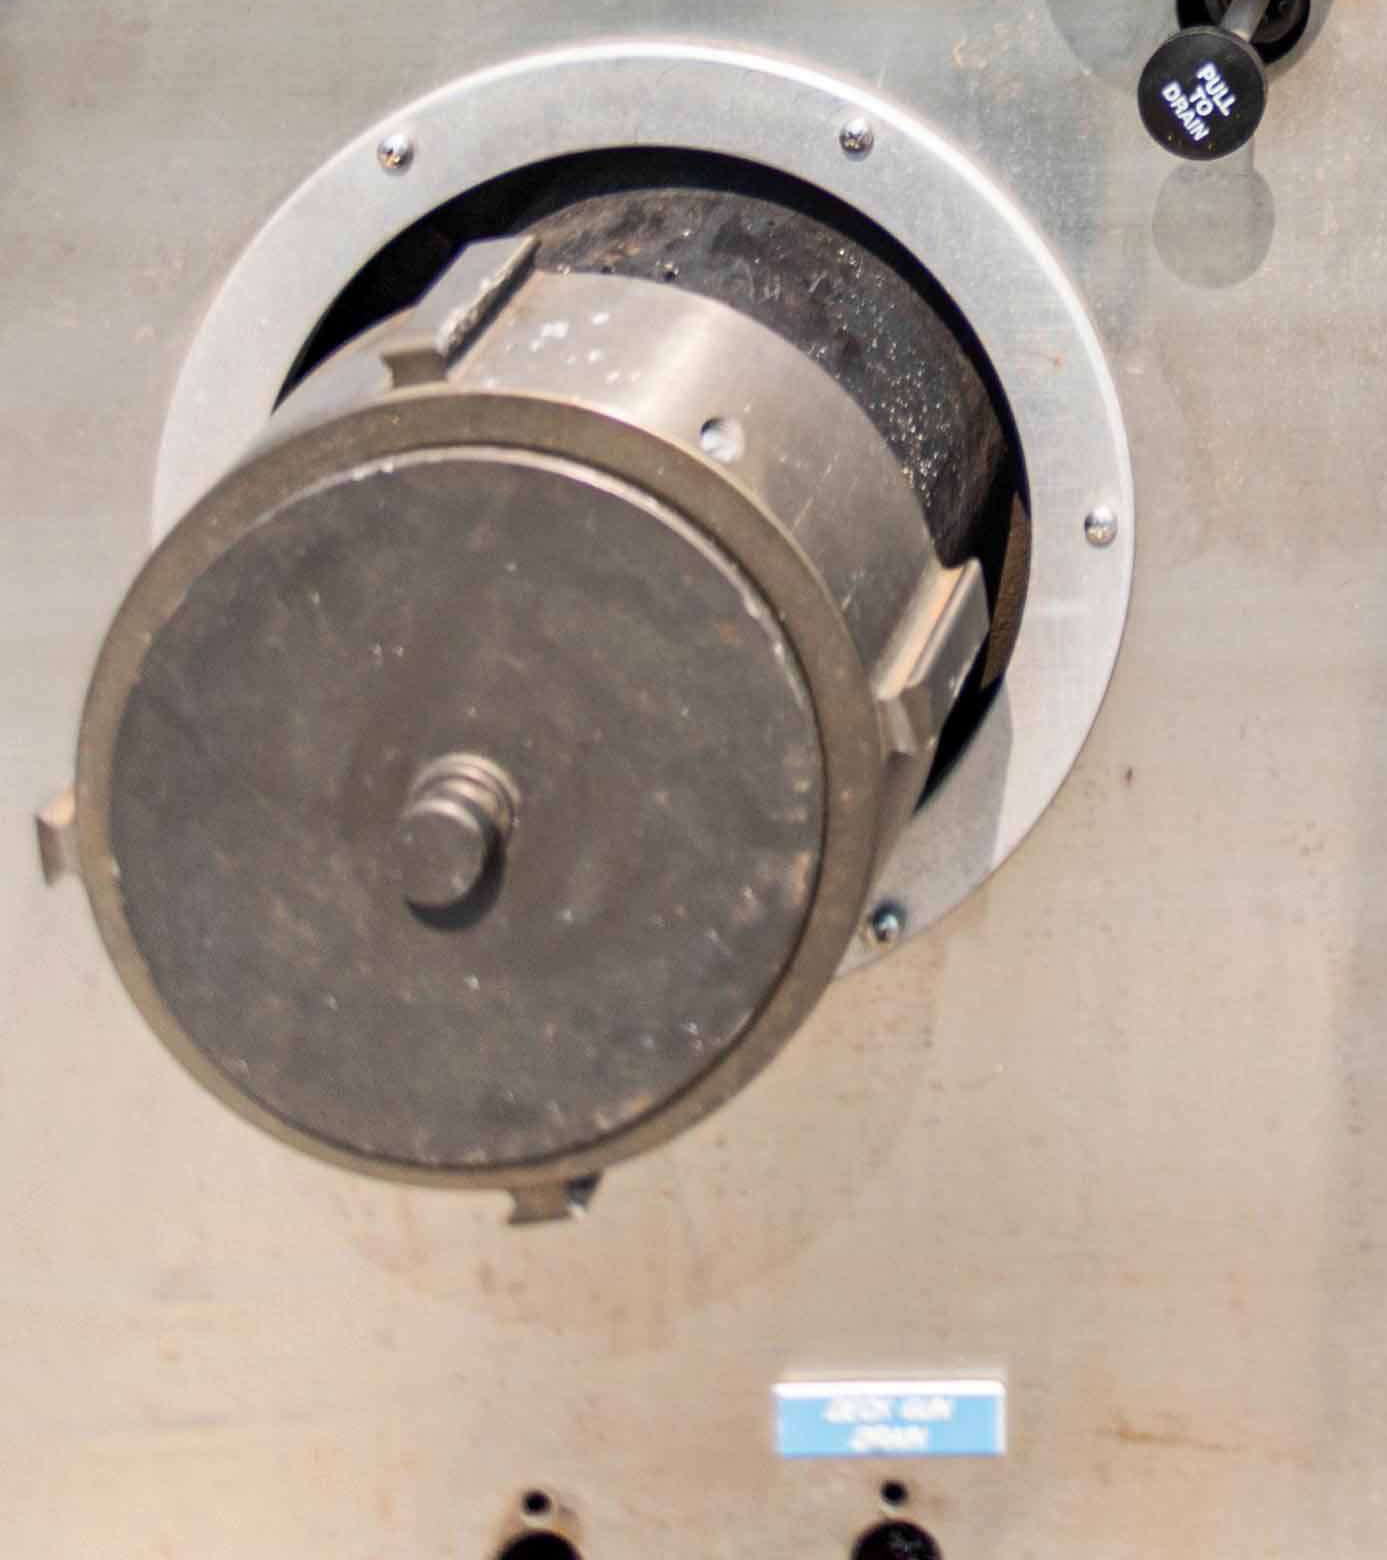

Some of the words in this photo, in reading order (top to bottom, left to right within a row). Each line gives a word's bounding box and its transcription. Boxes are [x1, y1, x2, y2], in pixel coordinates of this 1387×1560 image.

[1161, 81, 1211, 141] DRAIN
[1189, 86, 1214, 117] TO
[1197, 63, 1237, 117] PULL
